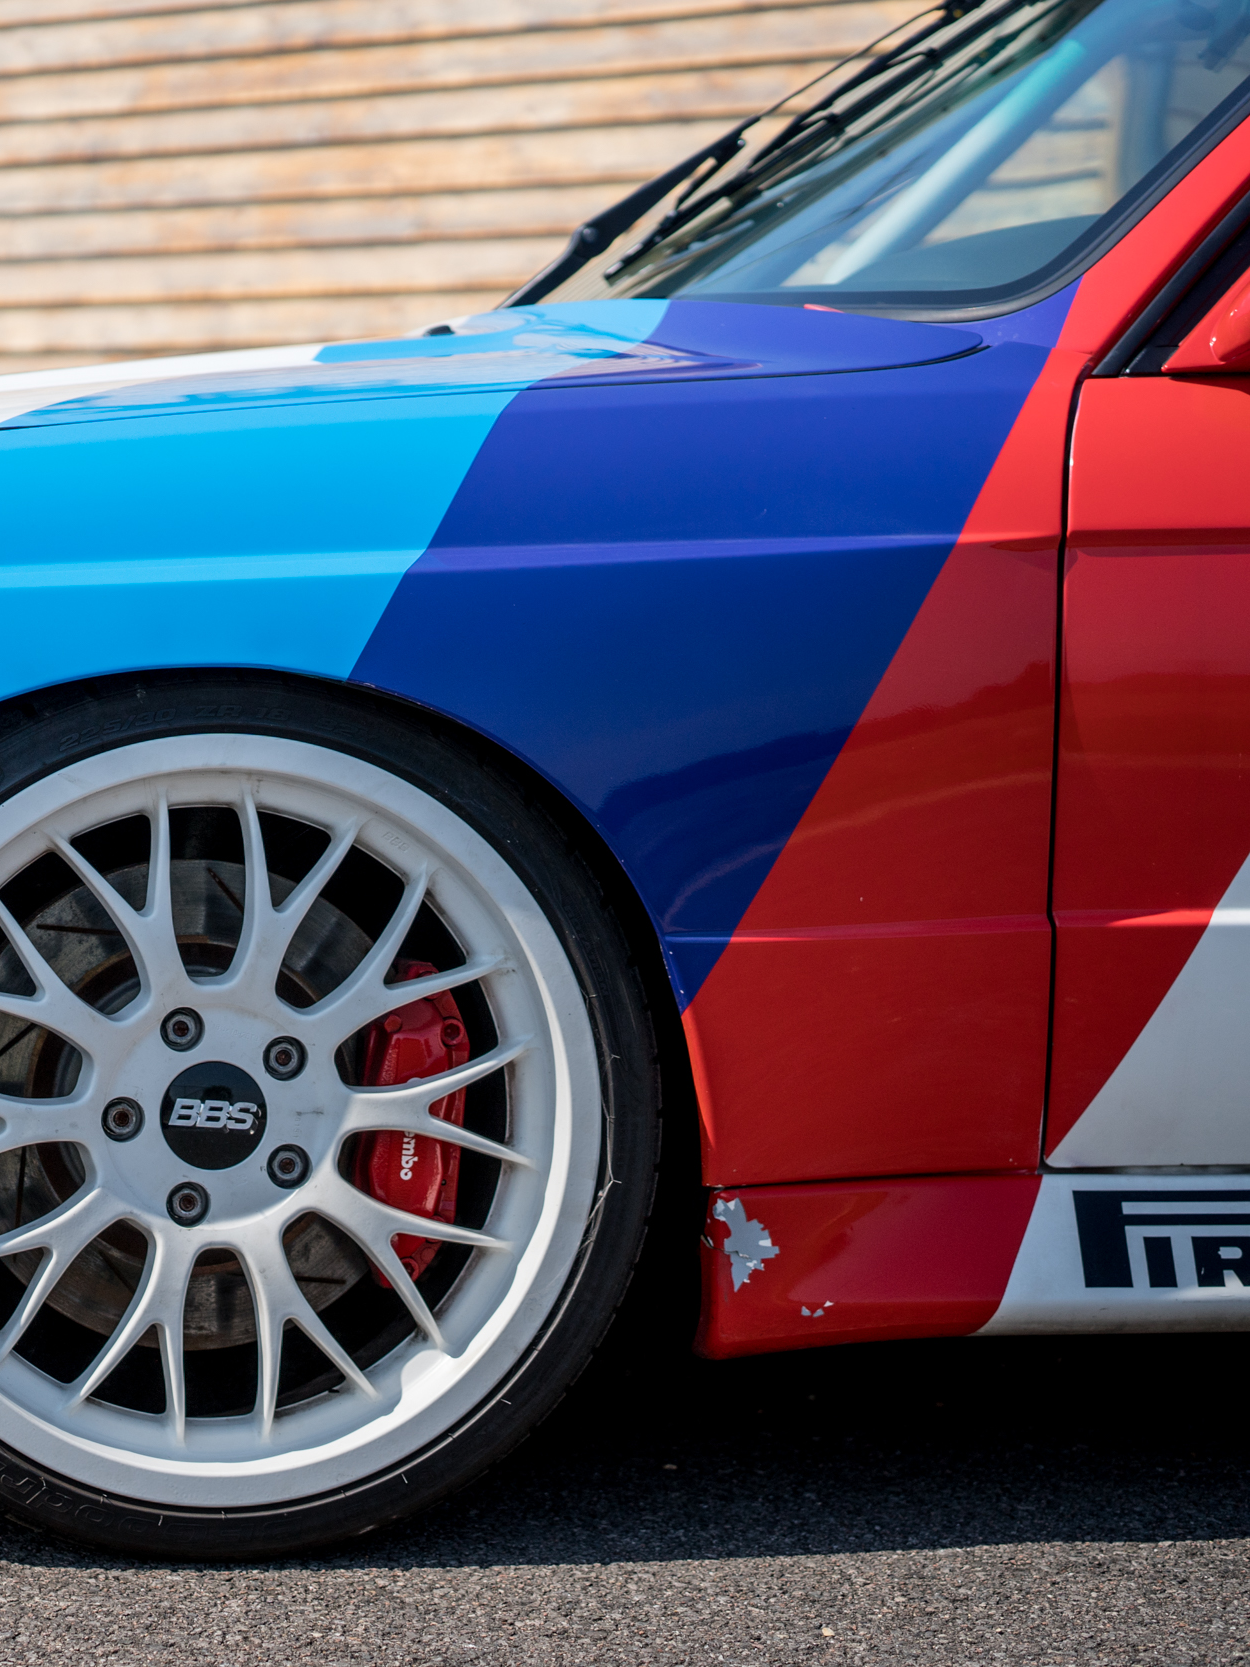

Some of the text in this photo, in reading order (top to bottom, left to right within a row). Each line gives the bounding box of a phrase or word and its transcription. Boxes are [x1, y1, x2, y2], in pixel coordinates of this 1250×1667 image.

[194, 704, 243, 718] ZR
[168, 1098, 259, 1131] BBS
[400, 1130, 418, 1181] embo
